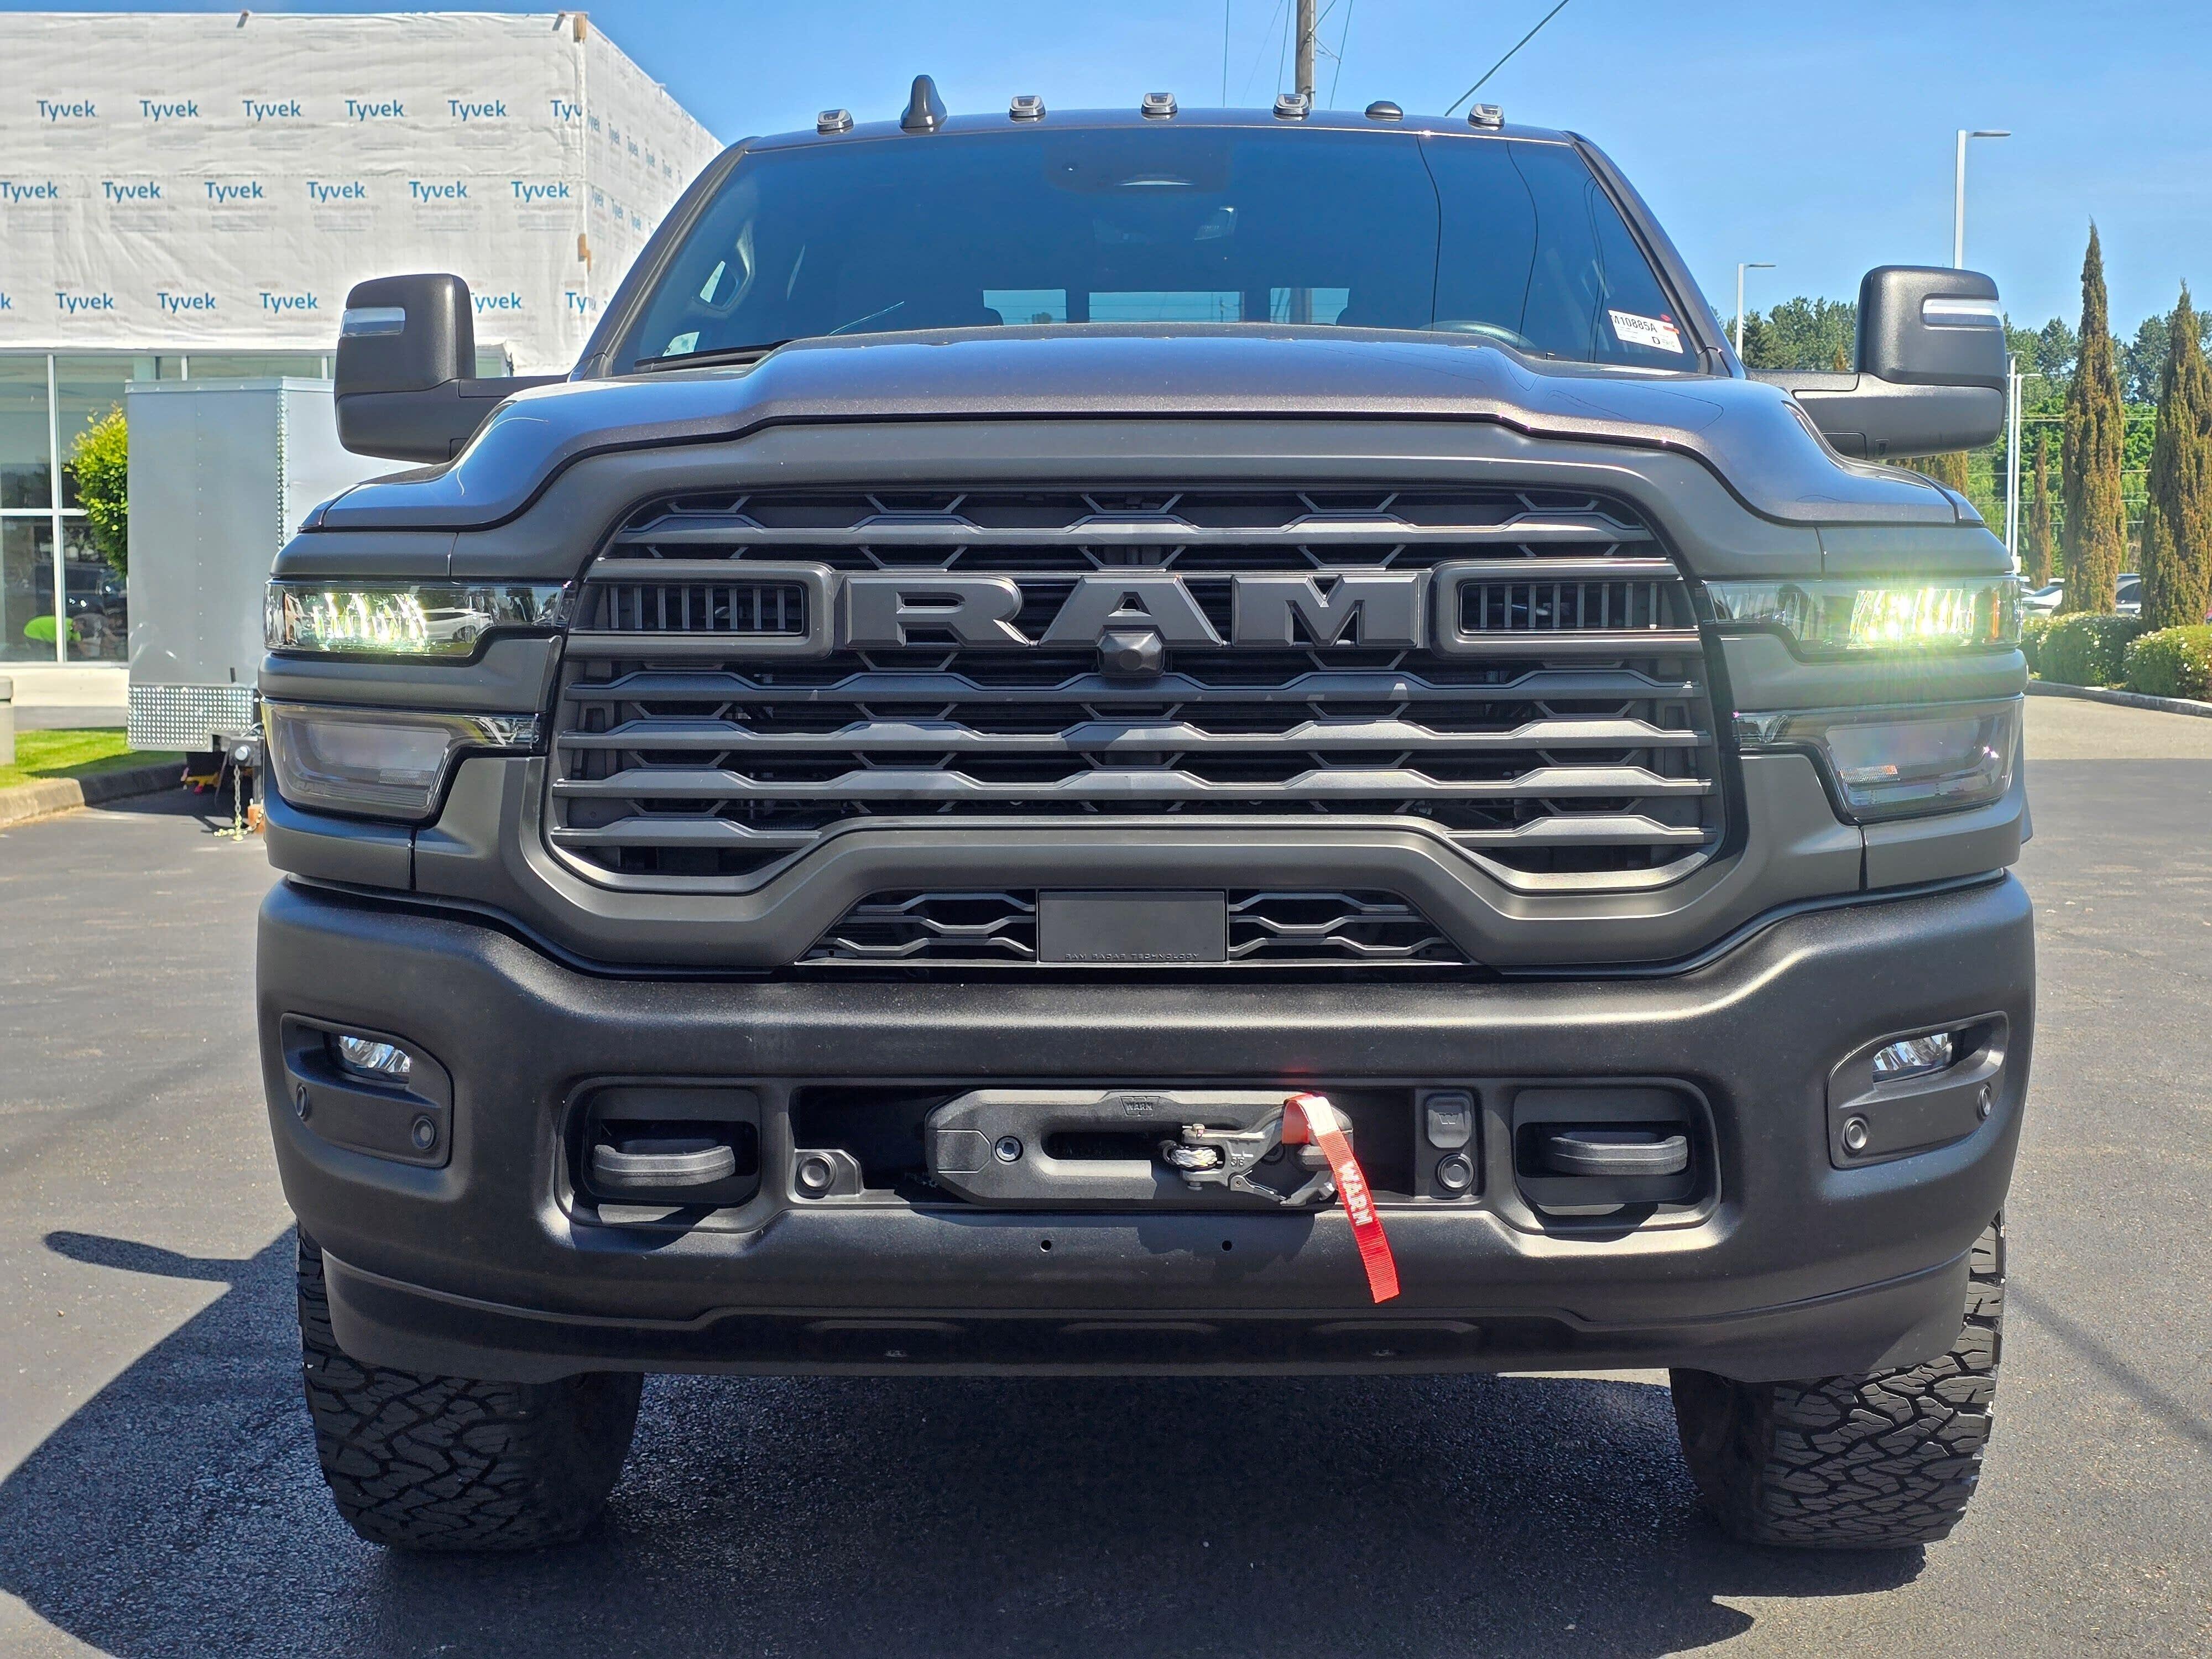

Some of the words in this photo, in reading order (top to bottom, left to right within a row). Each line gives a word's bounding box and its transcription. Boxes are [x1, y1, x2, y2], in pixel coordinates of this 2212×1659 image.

[36, 100, 96, 122] Tyvek
[139, 100, 199, 122] Tyvek
[242, 99, 301, 121] Tyvek
[345, 99, 404, 121] Tyvek
[447, 99, 507, 121] Tyvek
[550, 100, 582, 122] Tyv
[0, 181, 59, 203] Tyvek
[102, 181, 161, 203] Tyvek
[204, 181, 263, 203] Tyvek
[306, 181, 366, 202] Tyvek
[408, 180, 468, 202] Tyvek
[510, 180, 570, 203] Tyvek
[55, 292, 114, 314] Tyvek
[157, 292, 216, 314] Tyvek
[259, 292, 318, 314] Tyvek
[471, 291, 522, 314] yvek
[844, 575, 1418, 649] RAM
[1126, 1101, 1153, 1111] WARN
[1339, 1161, 1374, 1226] WARN
